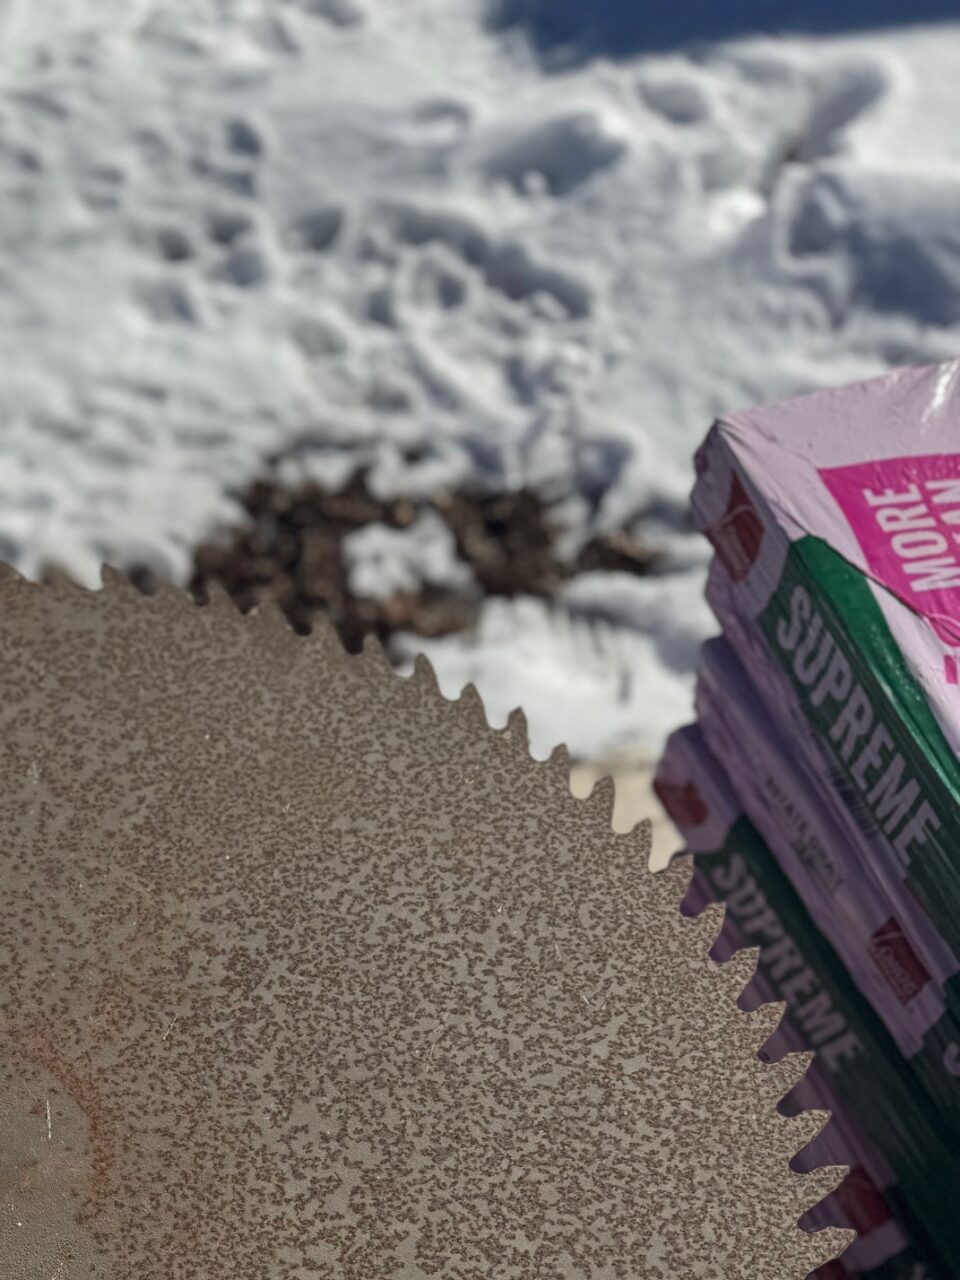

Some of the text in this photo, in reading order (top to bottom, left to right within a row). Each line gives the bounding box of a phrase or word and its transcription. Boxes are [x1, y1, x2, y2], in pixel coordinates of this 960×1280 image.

[862, 483, 960, 592] MORE
[776, 586, 941, 867] SUPREME
[710, 853, 866, 1072] SUPREME
